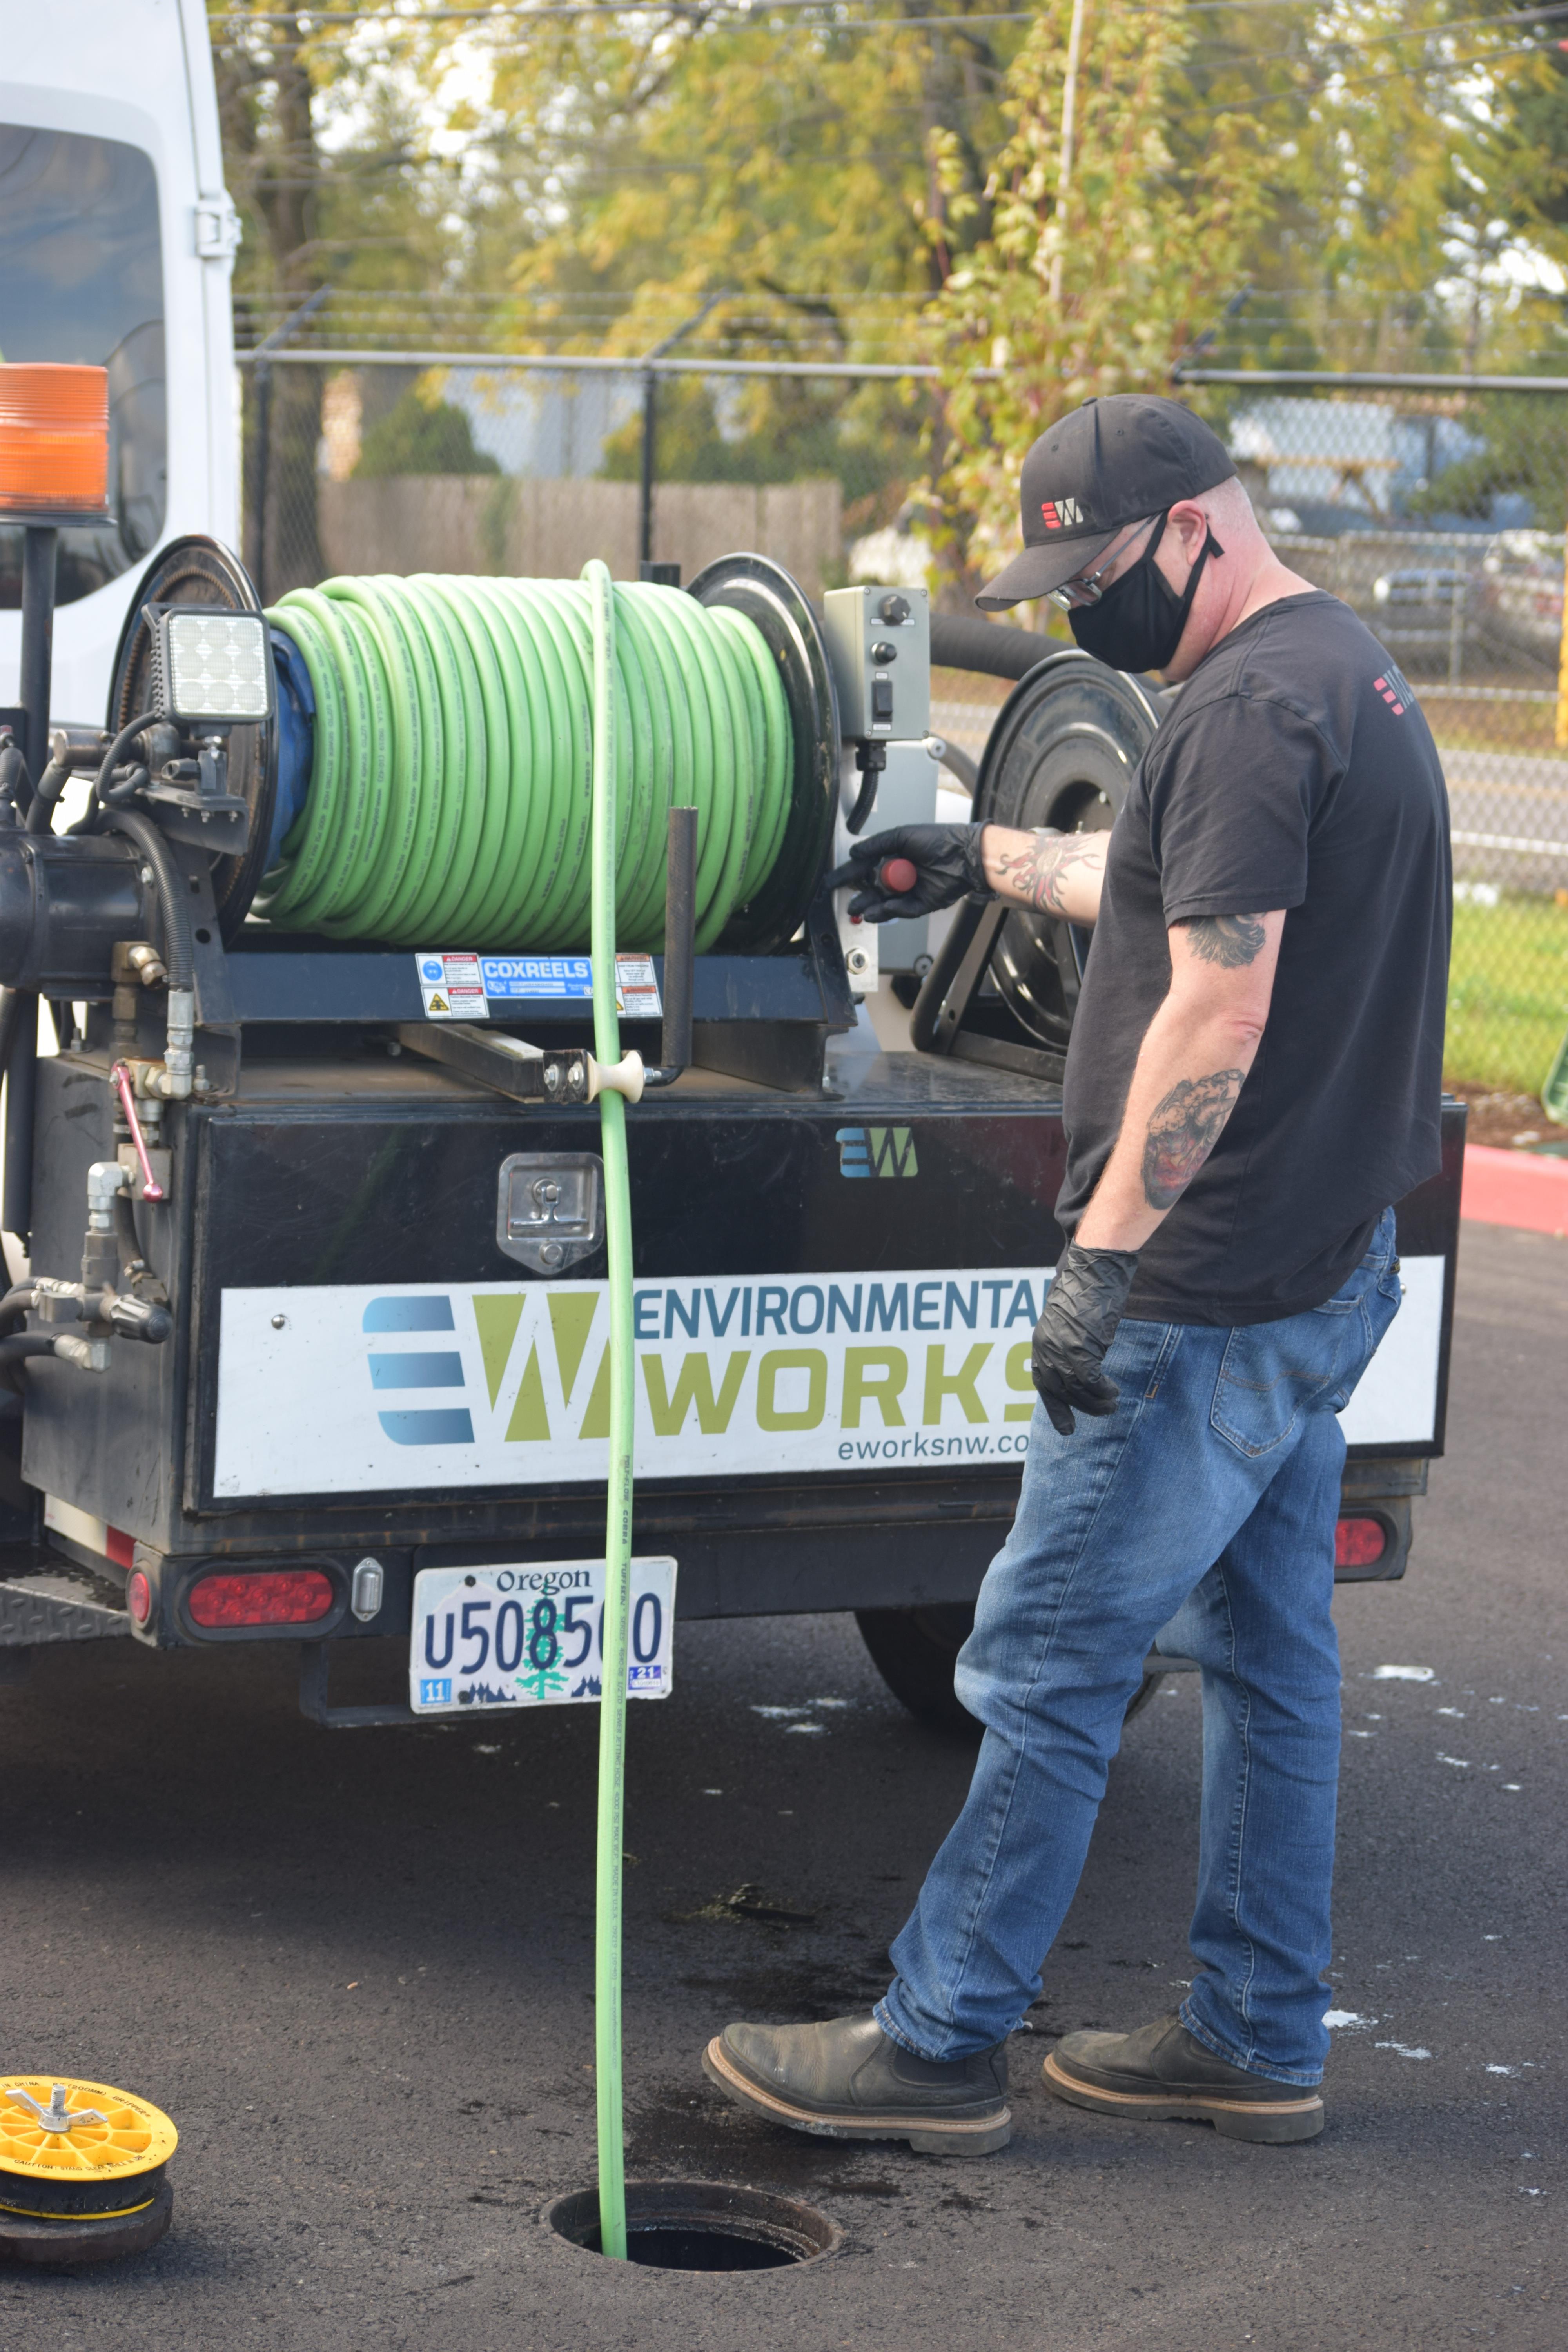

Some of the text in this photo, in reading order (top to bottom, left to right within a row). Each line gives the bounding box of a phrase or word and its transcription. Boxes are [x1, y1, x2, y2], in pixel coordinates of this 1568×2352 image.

[484, 962, 588, 978] COXREELS
[836, 1127, 918, 1178] EW
[633, 1279, 1052, 1339] ENVIRONMENTA
[838, 1433, 1029, 1460] eworksnw.co
[497, 1569, 592, 1595] Oregon
[425, 1592, 662, 1674] U50850
[637, 1667, 654, 1678] 21
[426, 1681, 444, 1701] 11
[612, 1887, 618, 1896] IN
[68, 2085, 107, 2096] (200MM)
